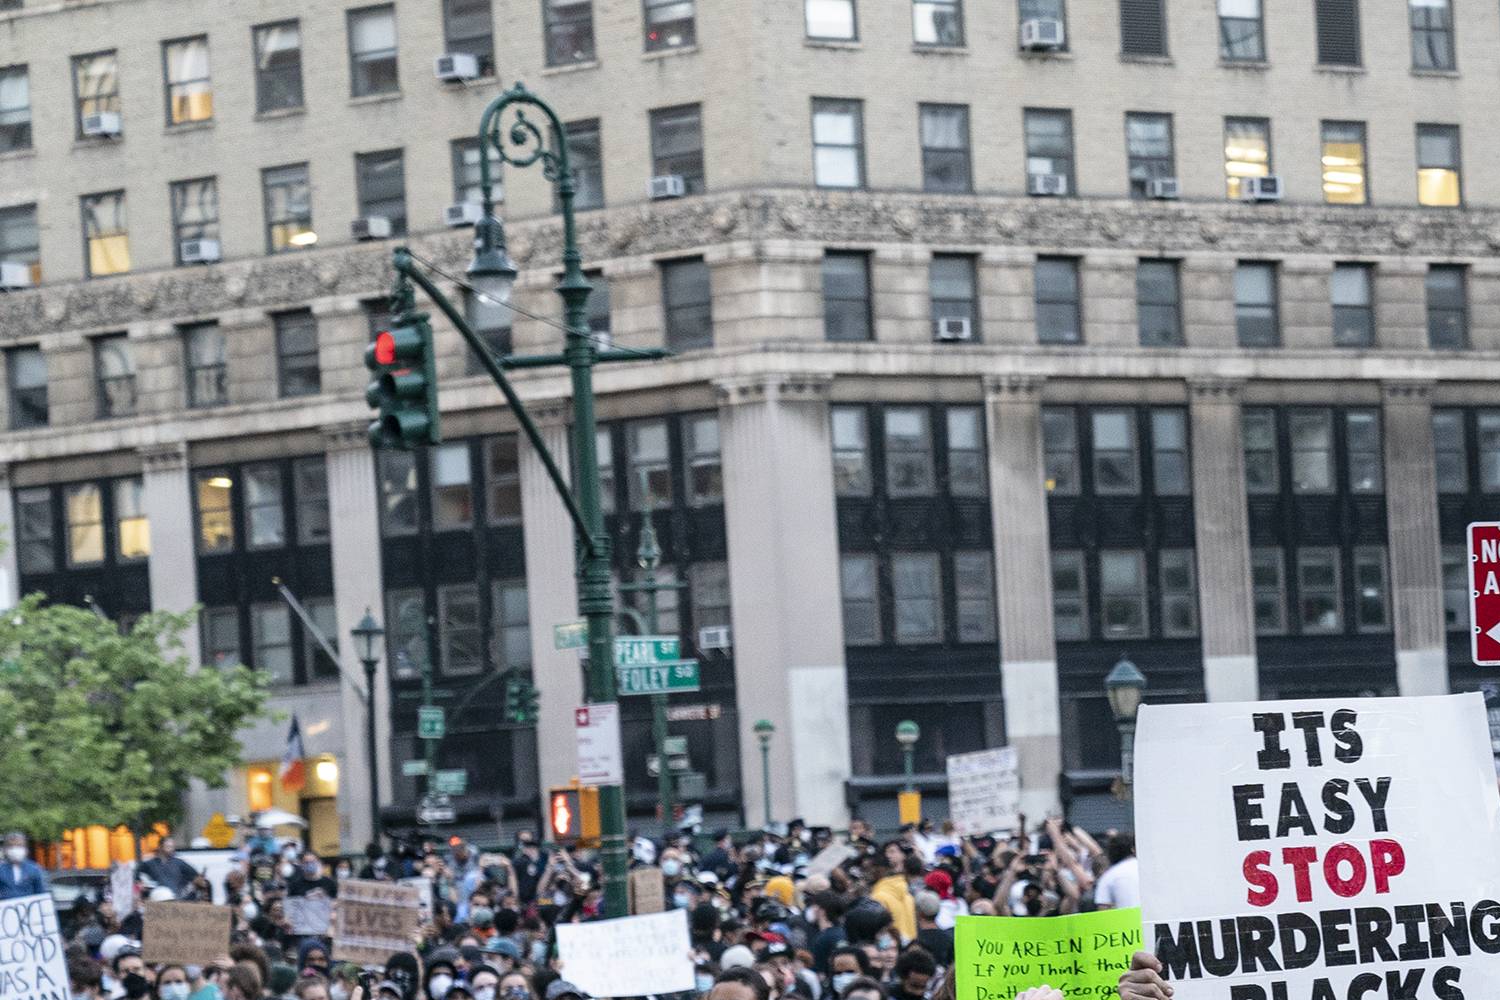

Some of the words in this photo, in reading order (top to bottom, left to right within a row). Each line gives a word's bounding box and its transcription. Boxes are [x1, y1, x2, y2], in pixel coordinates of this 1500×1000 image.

[614, 641, 656, 664] PEARL
[660, 643, 676, 655] ST
[621, 667, 670, 691] FOLEY
[674, 665, 694, 679] SQ
[1252, 709, 1364, 770] ITS
[1232, 777, 1392, 842] EASY
[1242, 838, 1406, 907] STOP
[976, 939, 1004, 956] YOU
[1012, 941, 1048, 958] ARE
[1055, 937, 1082, 956] IN
[1094, 954, 1131, 972] that
[36, 965, 56, 989] A
